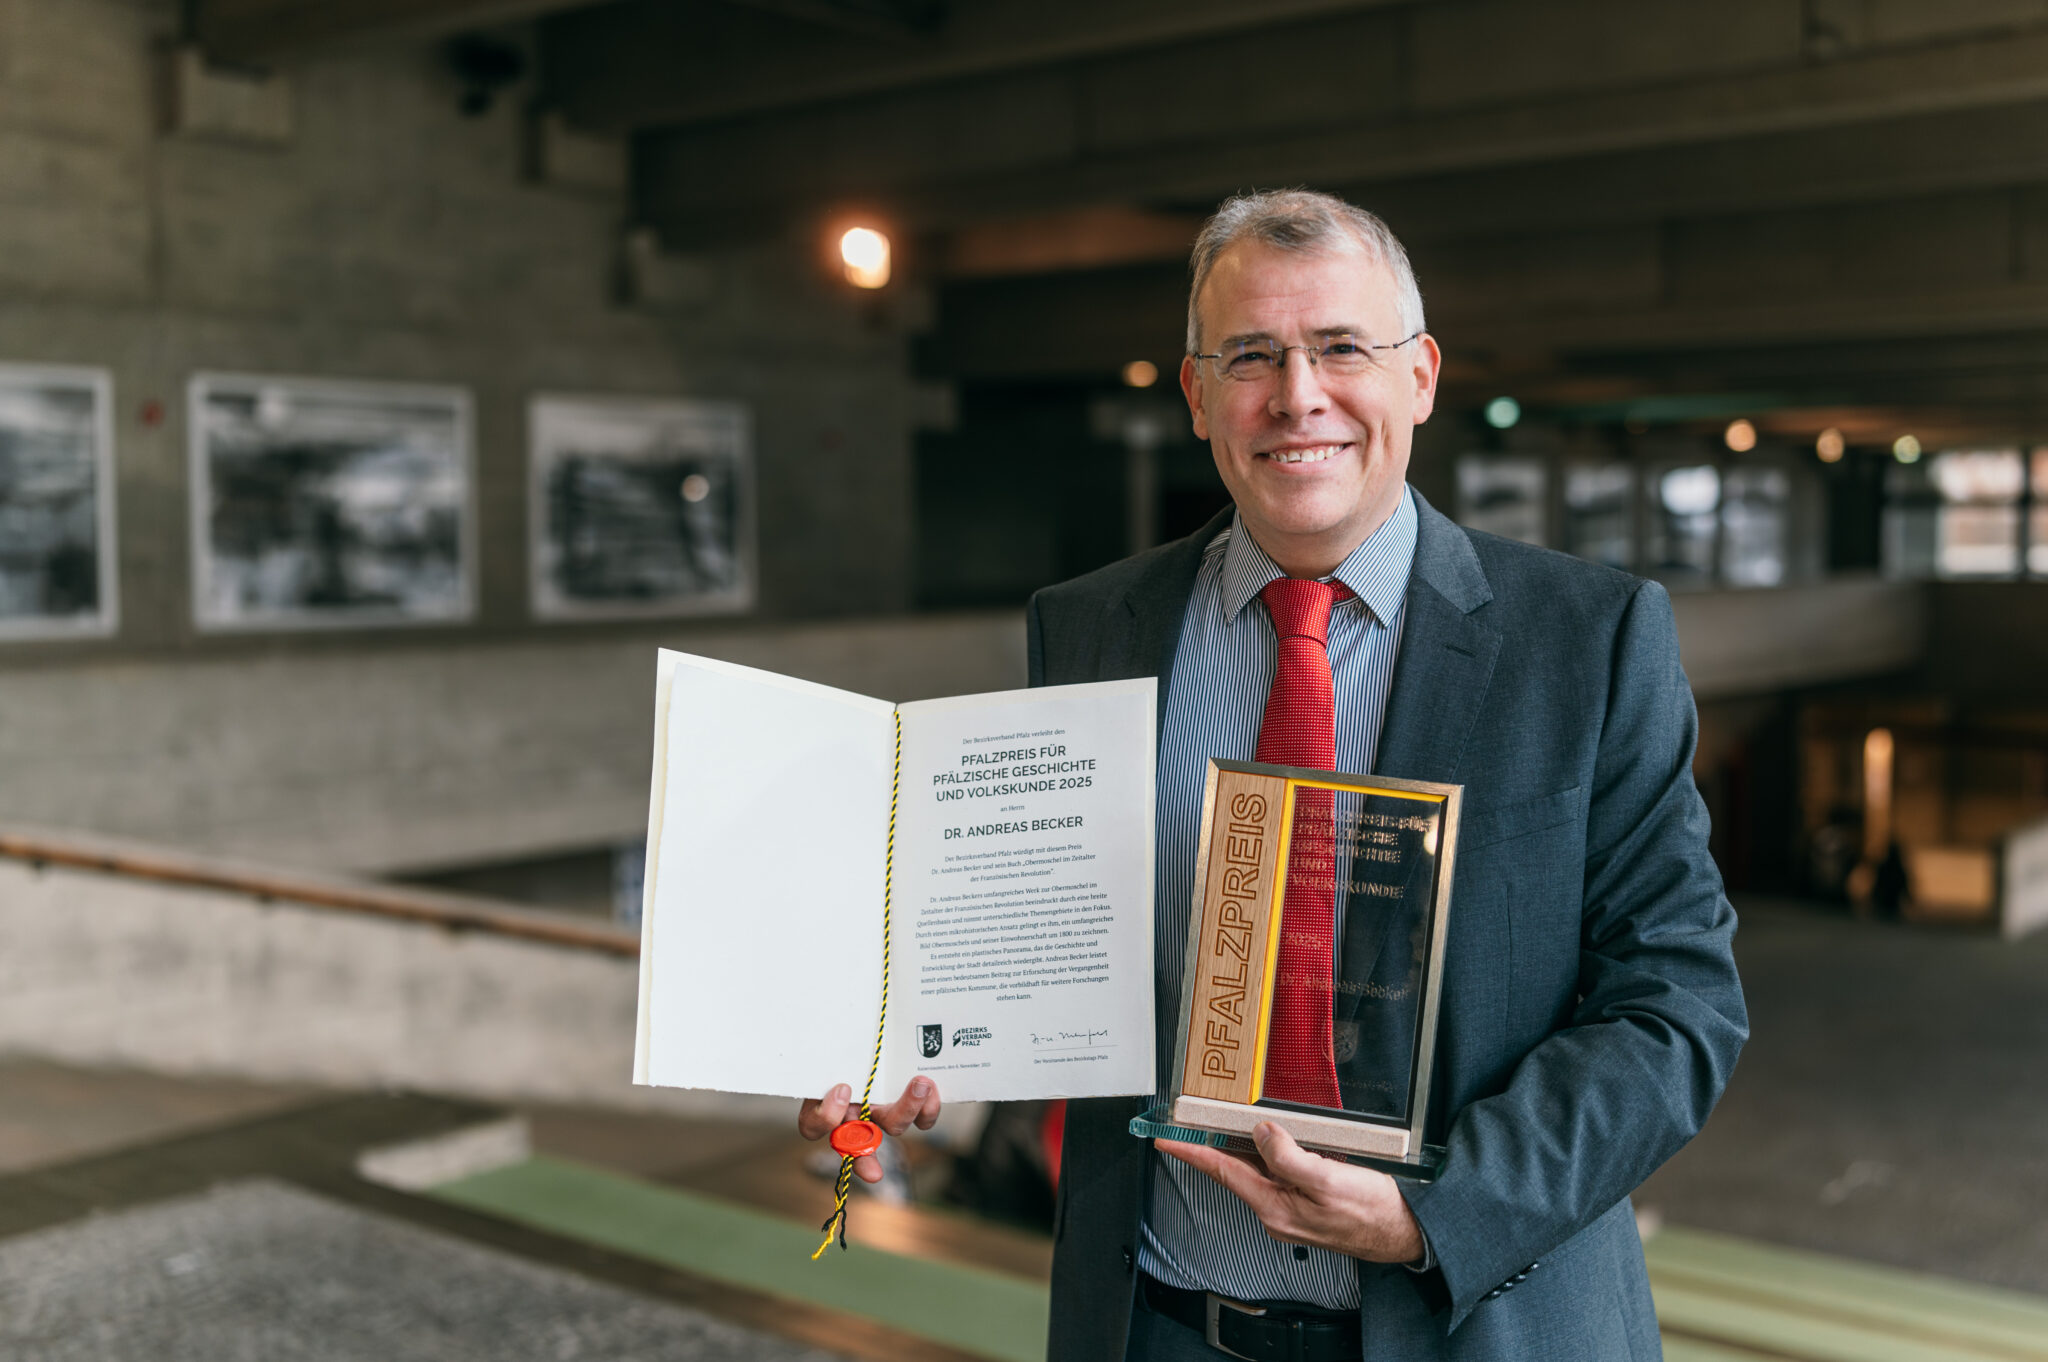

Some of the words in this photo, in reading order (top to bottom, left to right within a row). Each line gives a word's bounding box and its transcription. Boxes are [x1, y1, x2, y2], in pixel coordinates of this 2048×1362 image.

[961, 748, 1036, 766] PFALZPREIS
[1040, 743, 1066, 758] FÜR
[933, 767, 1008, 785] PFÄLZISCHE
[1012, 758, 1096, 777] GESCHICHTE
[936, 788, 964, 801] UND
[967, 779, 1055, 798] VOLKSKUNDE
[1058, 775, 1092, 789] 2025
[944, 827, 964, 839] DR.
[967, 820, 1029, 837] ANDREAS
[1031, 815, 1083, 831] BECKER
[955, 851, 996, 861] Bezirksverband
[997, 849, 1011, 857] Pfalz
[1071, 853, 1095, 861] Zeitalter
[980, 872, 1019, 881] Französischen
[983, 888, 1024, 897] umfangreiches
[1051, 882, 1088, 891] Obermoschel
[920, 907, 943, 915] Zeitalter
[954, 903, 993, 912] Französischen
[994, 900, 1024, 908] Revolution
[1024, 896, 1058, 905] beeindruckt
[1059, 894, 1076, 902] durch
[982, 911, 1029, 920] unterschiedliche
[1029, 907, 1073, 916] Themengebiete
[948, 925, 998, 935] mikrohistorischen
[1019, 922, 1039, 930] gelingt
[1071, 915, 1113, 924] umfangreiches
[931, 939, 969, 948] Obermoschels
[1000, 932, 1047, 942] Einwohnerschaft
[1202, 793, 1267, 1080] PFALZPREIS
[937, 951, 960, 959] entsteht
[971, 948, 1001, 957] plastisches
[1054, 941, 1085, 949] Geschichte
[1086, 939, 1097, 947] und
[921, 964, 955, 972] Entwicklung
[981, 958, 1012, 967] detailreich
[1012, 956, 1044, 964] wiedergibt.
[1068, 952, 1088, 960] Becker
[953, 973, 989, 981] bedeutsamen
[1022, 967, 1056, 975] Erforschung
[1068, 962, 1109, 972] Vergangenheit
[1008, 979, 1040, 988] vorbildhaft
[1072, 975, 1109, 983] Forschungen
[996, 993, 1015, 1001] stehen
[961, 1026, 987, 1034] BEZIRKS
[961, 1032, 992, 1040] VERBAND
